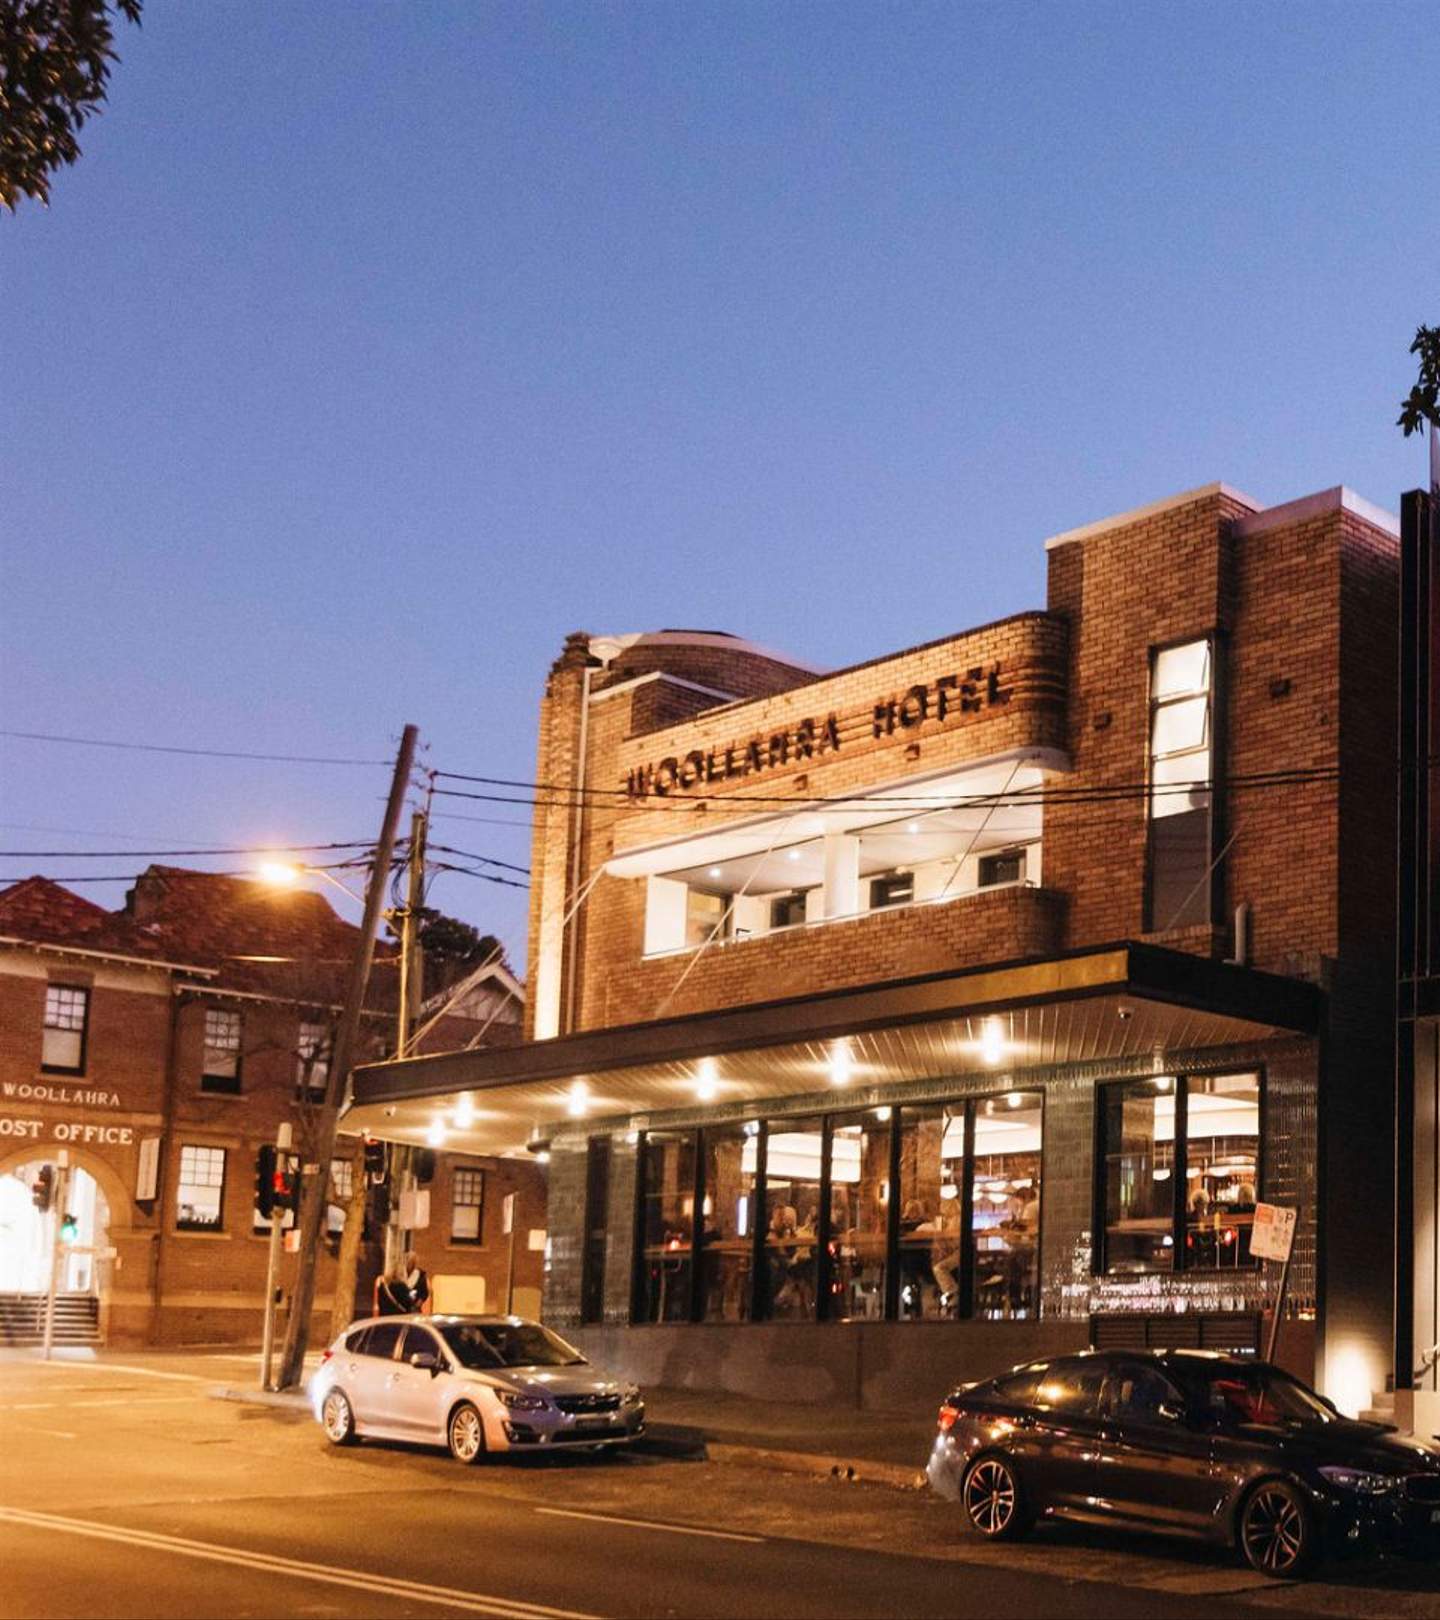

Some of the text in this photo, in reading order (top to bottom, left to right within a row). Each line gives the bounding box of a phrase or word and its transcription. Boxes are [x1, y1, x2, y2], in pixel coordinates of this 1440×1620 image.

[873, 660, 1014, 740] HOTEL
[3, 1082, 120, 1106] WOOLLAHRA
[54, 1123, 133, 1145] OFFICE
